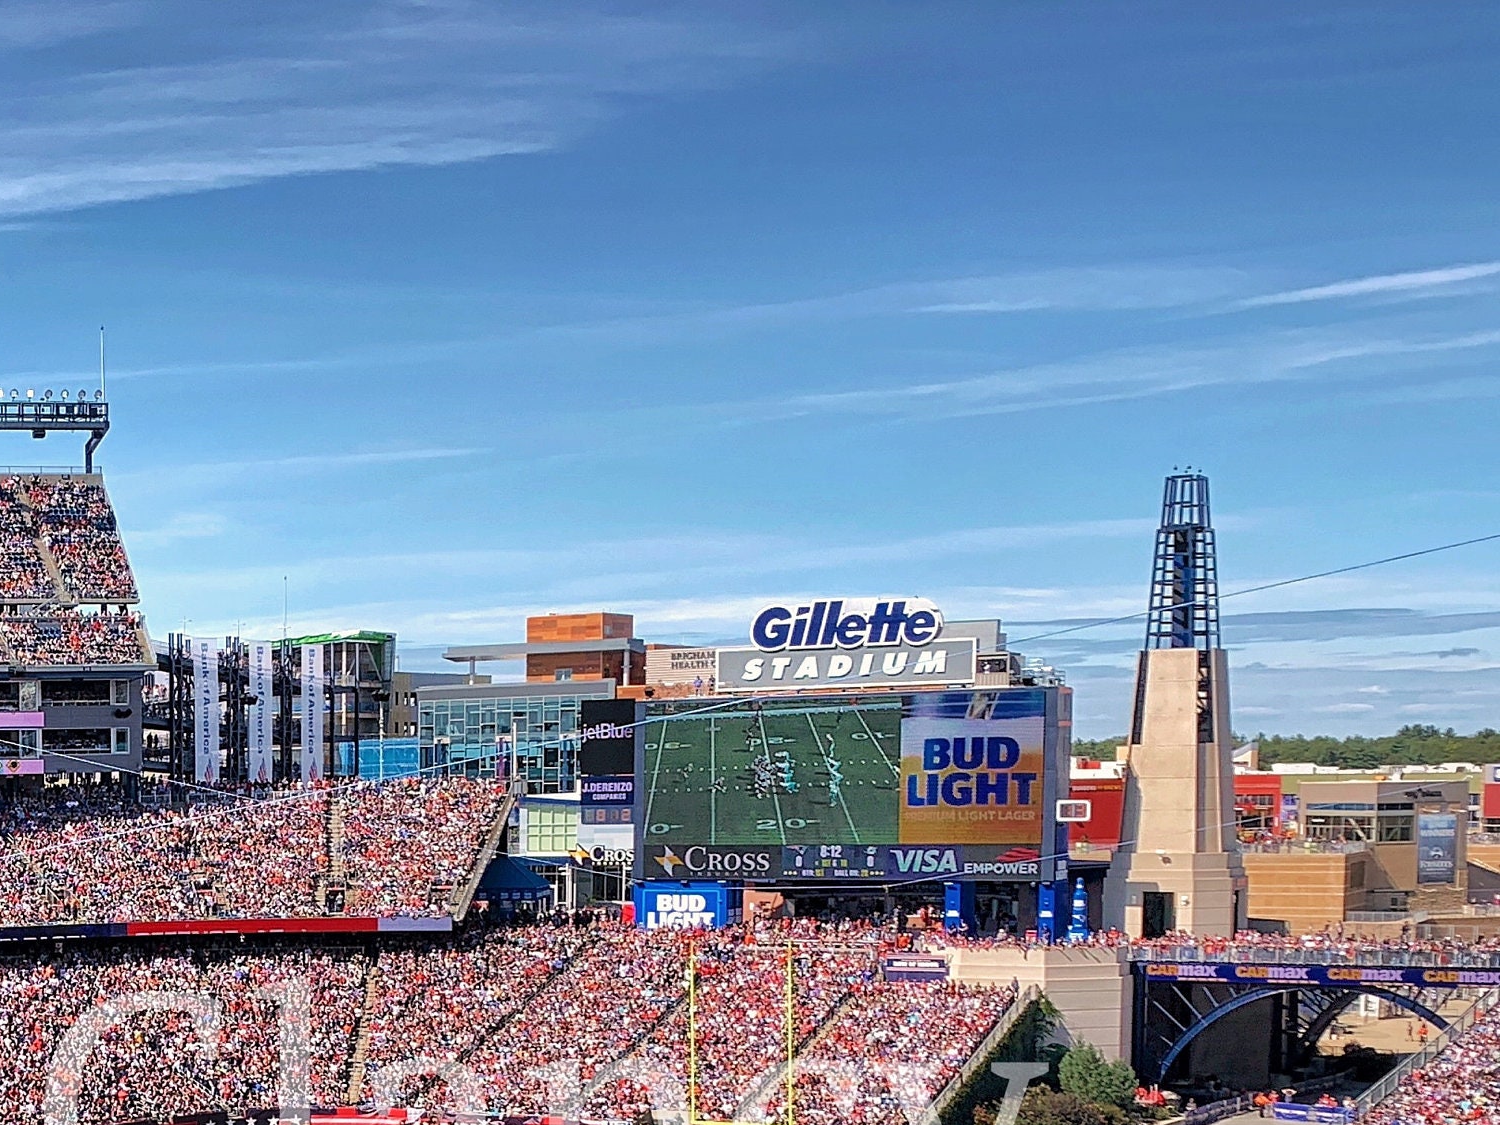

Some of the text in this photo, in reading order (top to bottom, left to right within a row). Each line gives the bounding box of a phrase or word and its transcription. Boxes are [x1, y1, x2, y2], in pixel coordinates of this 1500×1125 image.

[752, 600, 937, 648] Gillette
[741, 650, 947, 681] STADIUM
[582, 723, 634, 743] jetBlue
[923, 736, 1020, 770] BUD
[906, 772, 1038, 807] LIGHT
[958, 811, 997, 821] LIGHT
[997, 810, 1036, 821] LAGER
[685, 846, 771, 872] CROSS
[892, 849, 957, 873] VISA
[964, 863, 1038, 874] EMPOWER
[655, 894, 707, 912] BUD
[646, 912, 716, 929] LIGHT
